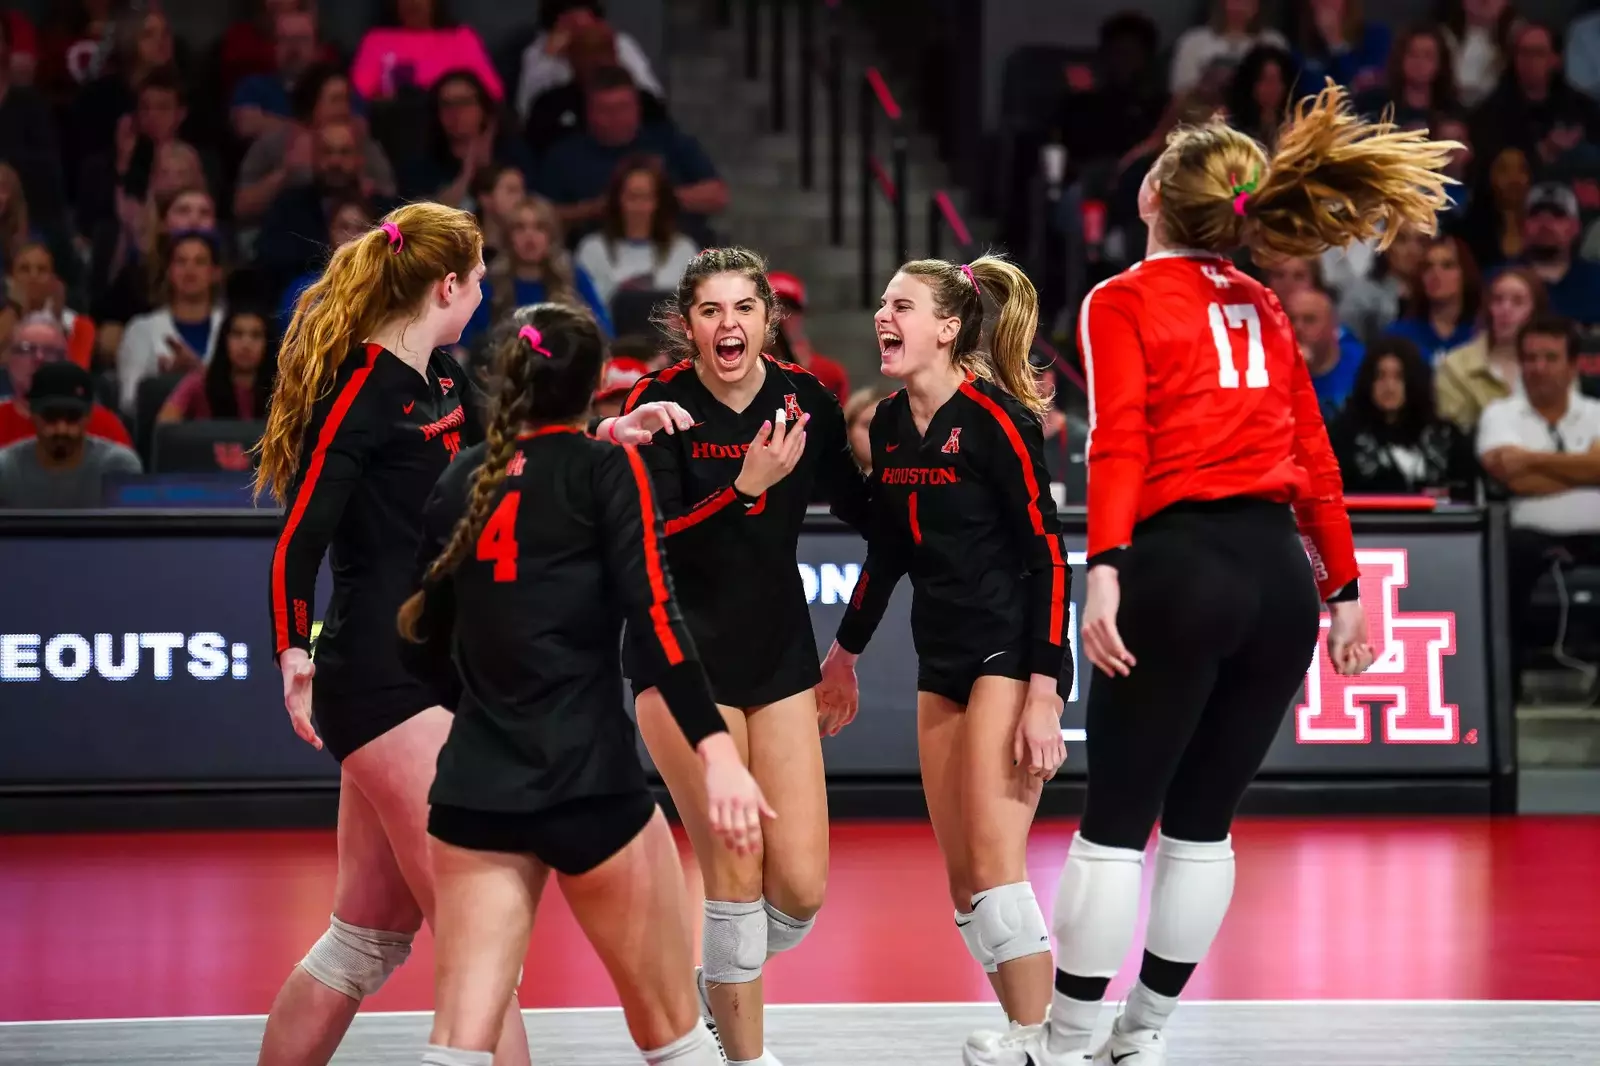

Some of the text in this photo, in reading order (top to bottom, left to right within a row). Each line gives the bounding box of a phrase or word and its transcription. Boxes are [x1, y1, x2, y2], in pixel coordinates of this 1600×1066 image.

[1208, 302, 1269, 388] 17
[881, 466, 958, 485] HOUSTON
[476, 490, 520, 582] 4
[908, 491, 922, 545] 1
[0, 632, 248, 681] EOUTS:
